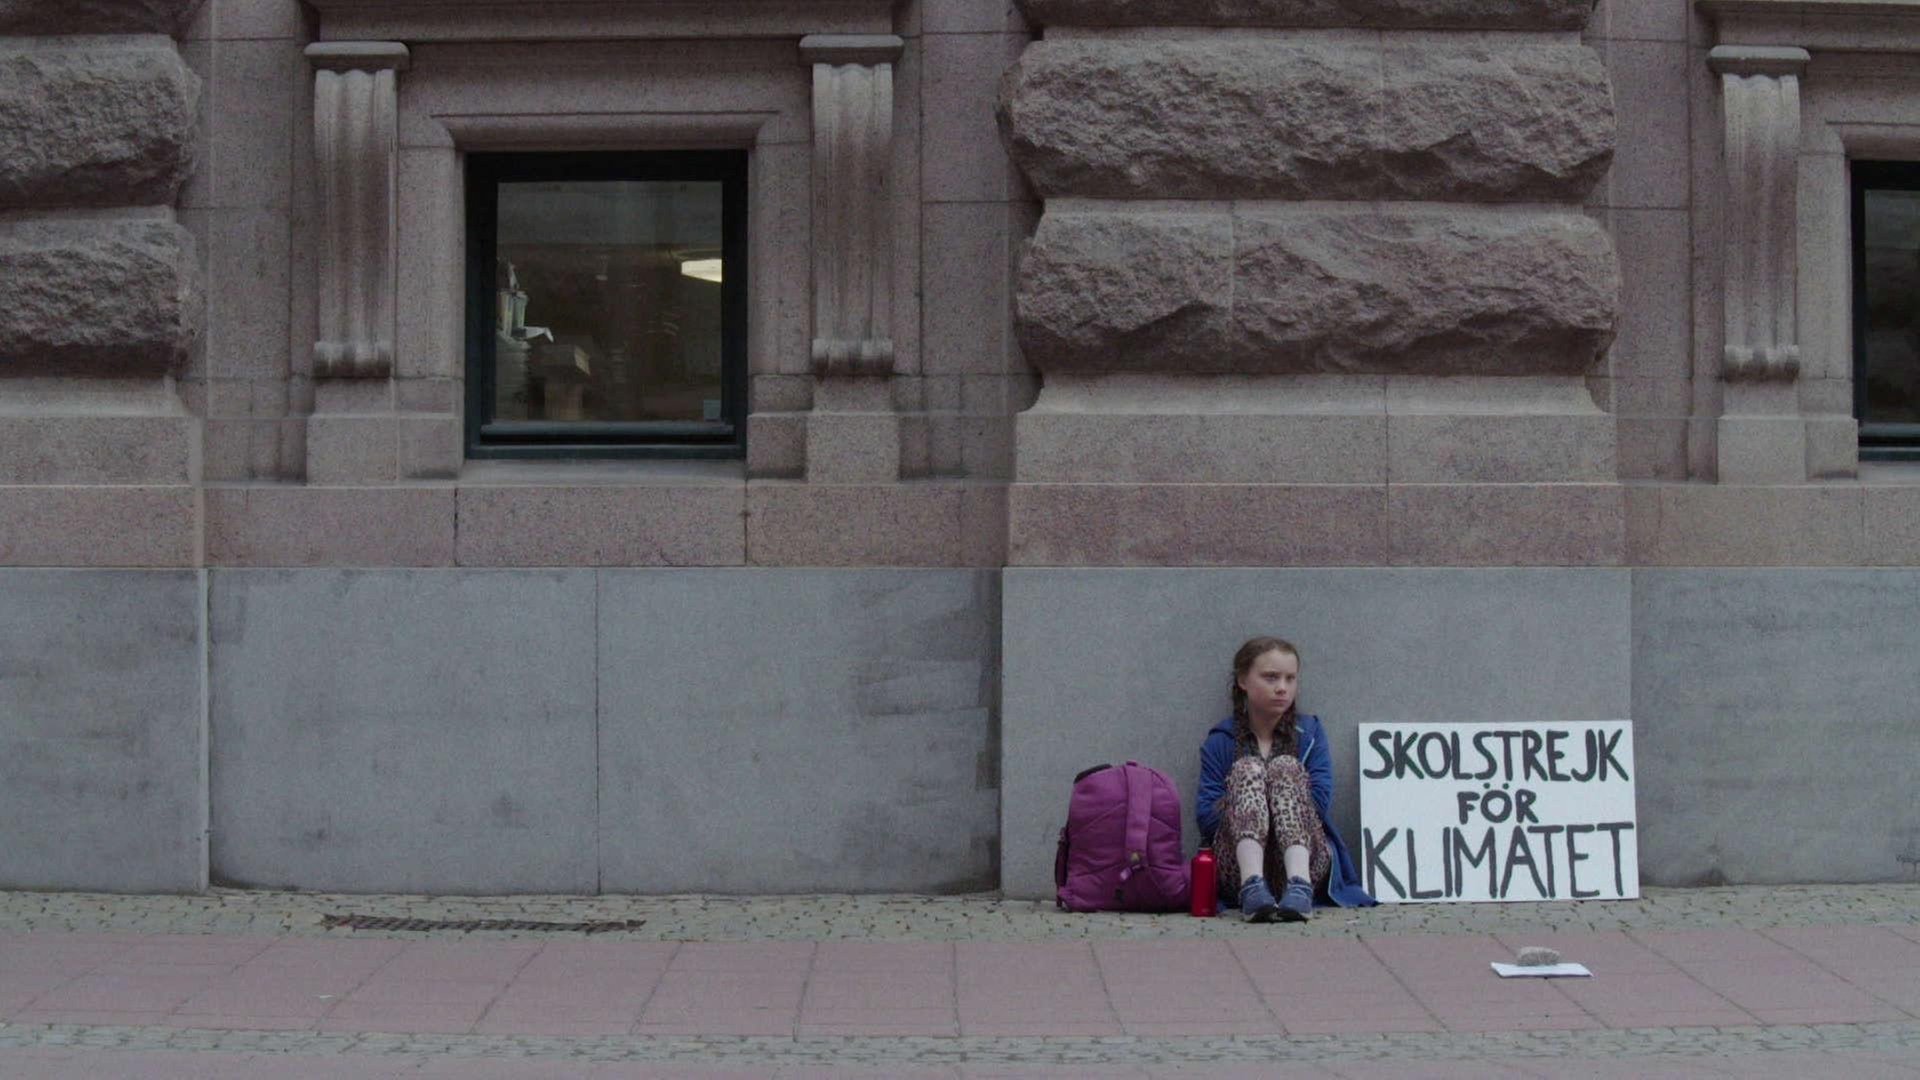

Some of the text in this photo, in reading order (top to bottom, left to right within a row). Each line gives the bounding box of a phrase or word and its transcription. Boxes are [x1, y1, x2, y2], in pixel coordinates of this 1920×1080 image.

[1363, 729, 1629, 782] SKOLSTREJK
[1457, 783, 1539, 825] FÖR
[1363, 822, 1634, 899] KLIMATET
